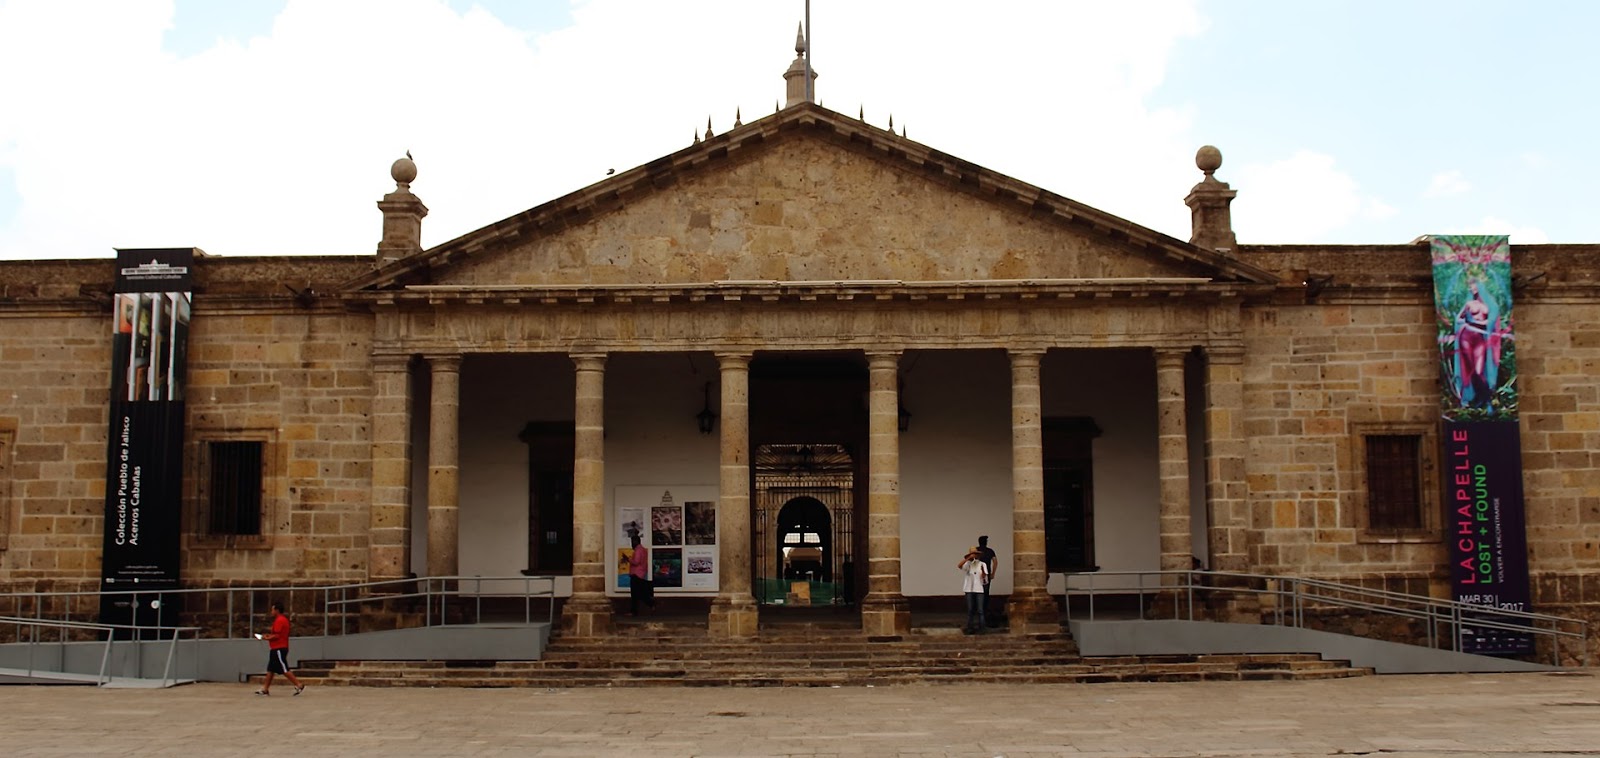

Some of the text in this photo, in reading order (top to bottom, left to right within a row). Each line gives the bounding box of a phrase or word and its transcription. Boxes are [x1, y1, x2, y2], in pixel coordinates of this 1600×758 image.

[115, 416, 130, 545] Colección Pueblo de Jalisco
[129, 465, 141, 545] Acervos Cabañas
[1453, 430, 1475, 584] LACHAPELLE
[1474, 464, 1489, 521] FOUND
[1493, 497, 1503, 549] ENCONTRARSE
[1478, 542, 1492, 583] LOST
[1460, 594, 1494, 604] MAR 30
[1500, 602, 1524, 613] 2017
